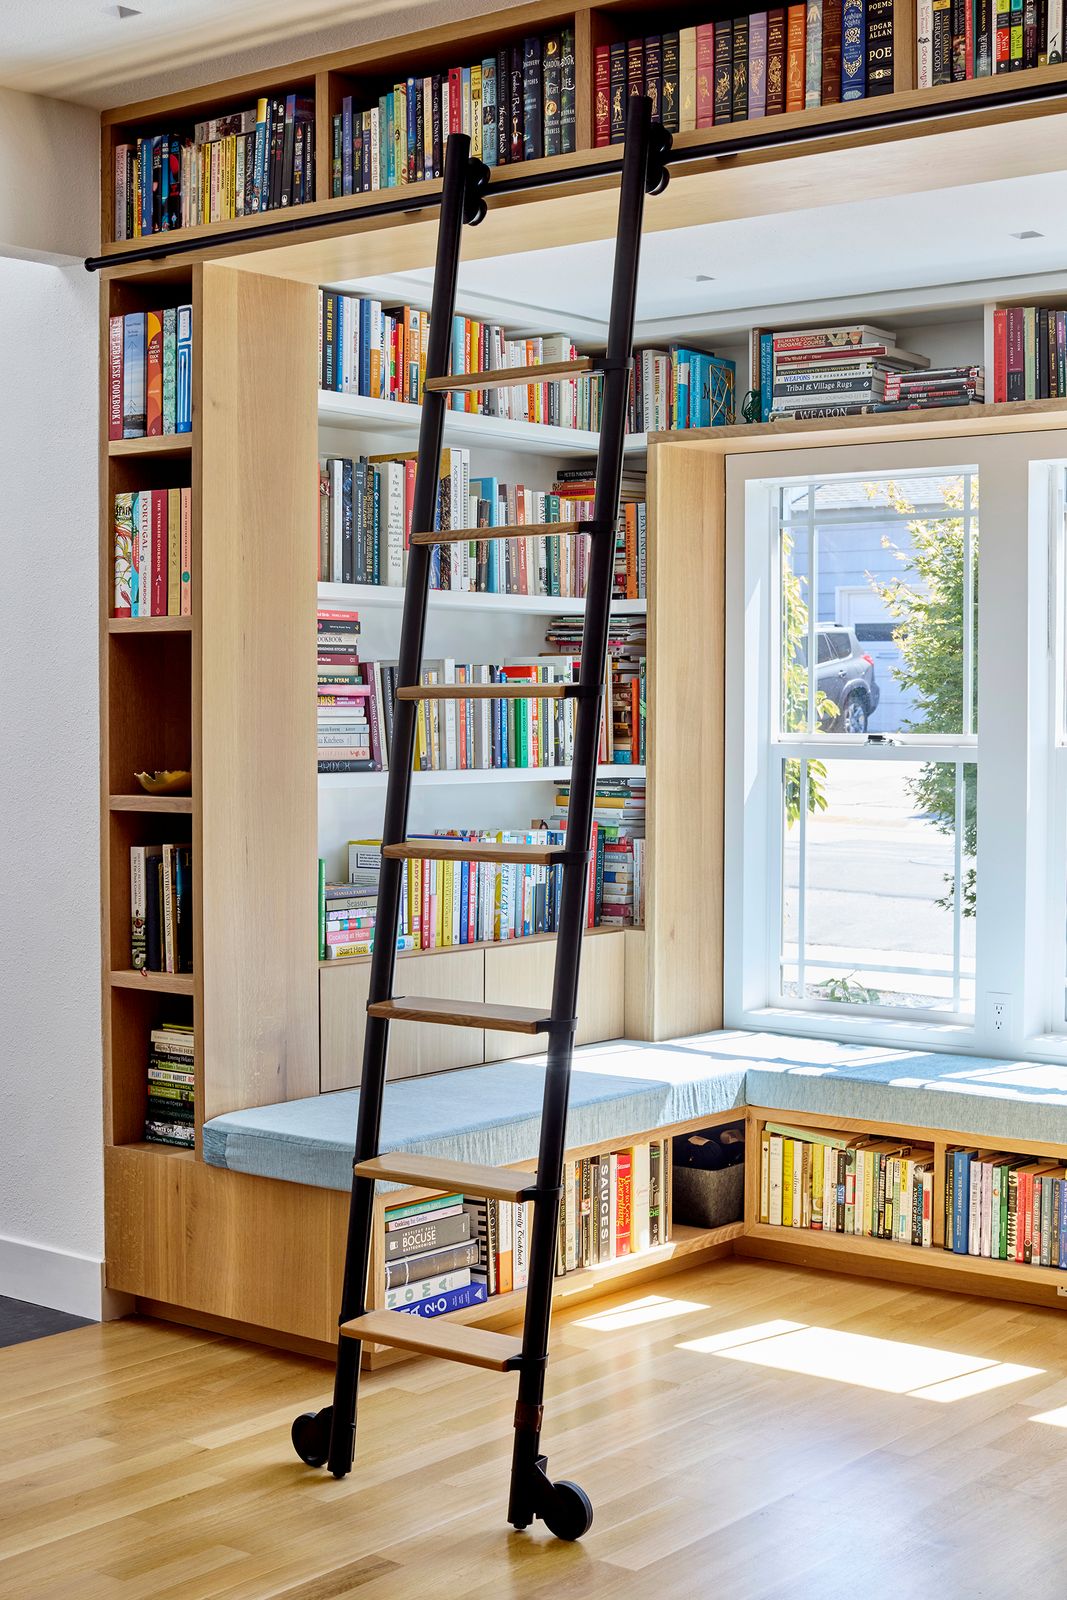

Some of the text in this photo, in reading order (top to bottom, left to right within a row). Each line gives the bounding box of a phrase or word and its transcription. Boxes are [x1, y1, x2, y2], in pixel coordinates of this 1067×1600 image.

[869, 22, 892, 39] EDGAR ALLAN
[869, 47, 892, 61] POE
[112, 342, 121, 379] LEBANESE
[786, 384, 805, 392] Tribal
[813, 382, 835, 390] Village
[836, 381, 852, 389] Rugs
[112, 380, 121, 420] COOKBOOK
[346, 900, 368, 908] Season
[340, 947, 353, 955] Start
[616, 1178, 626, 1228] Everything
[402, 1230, 436, 1248] BOCUSE
